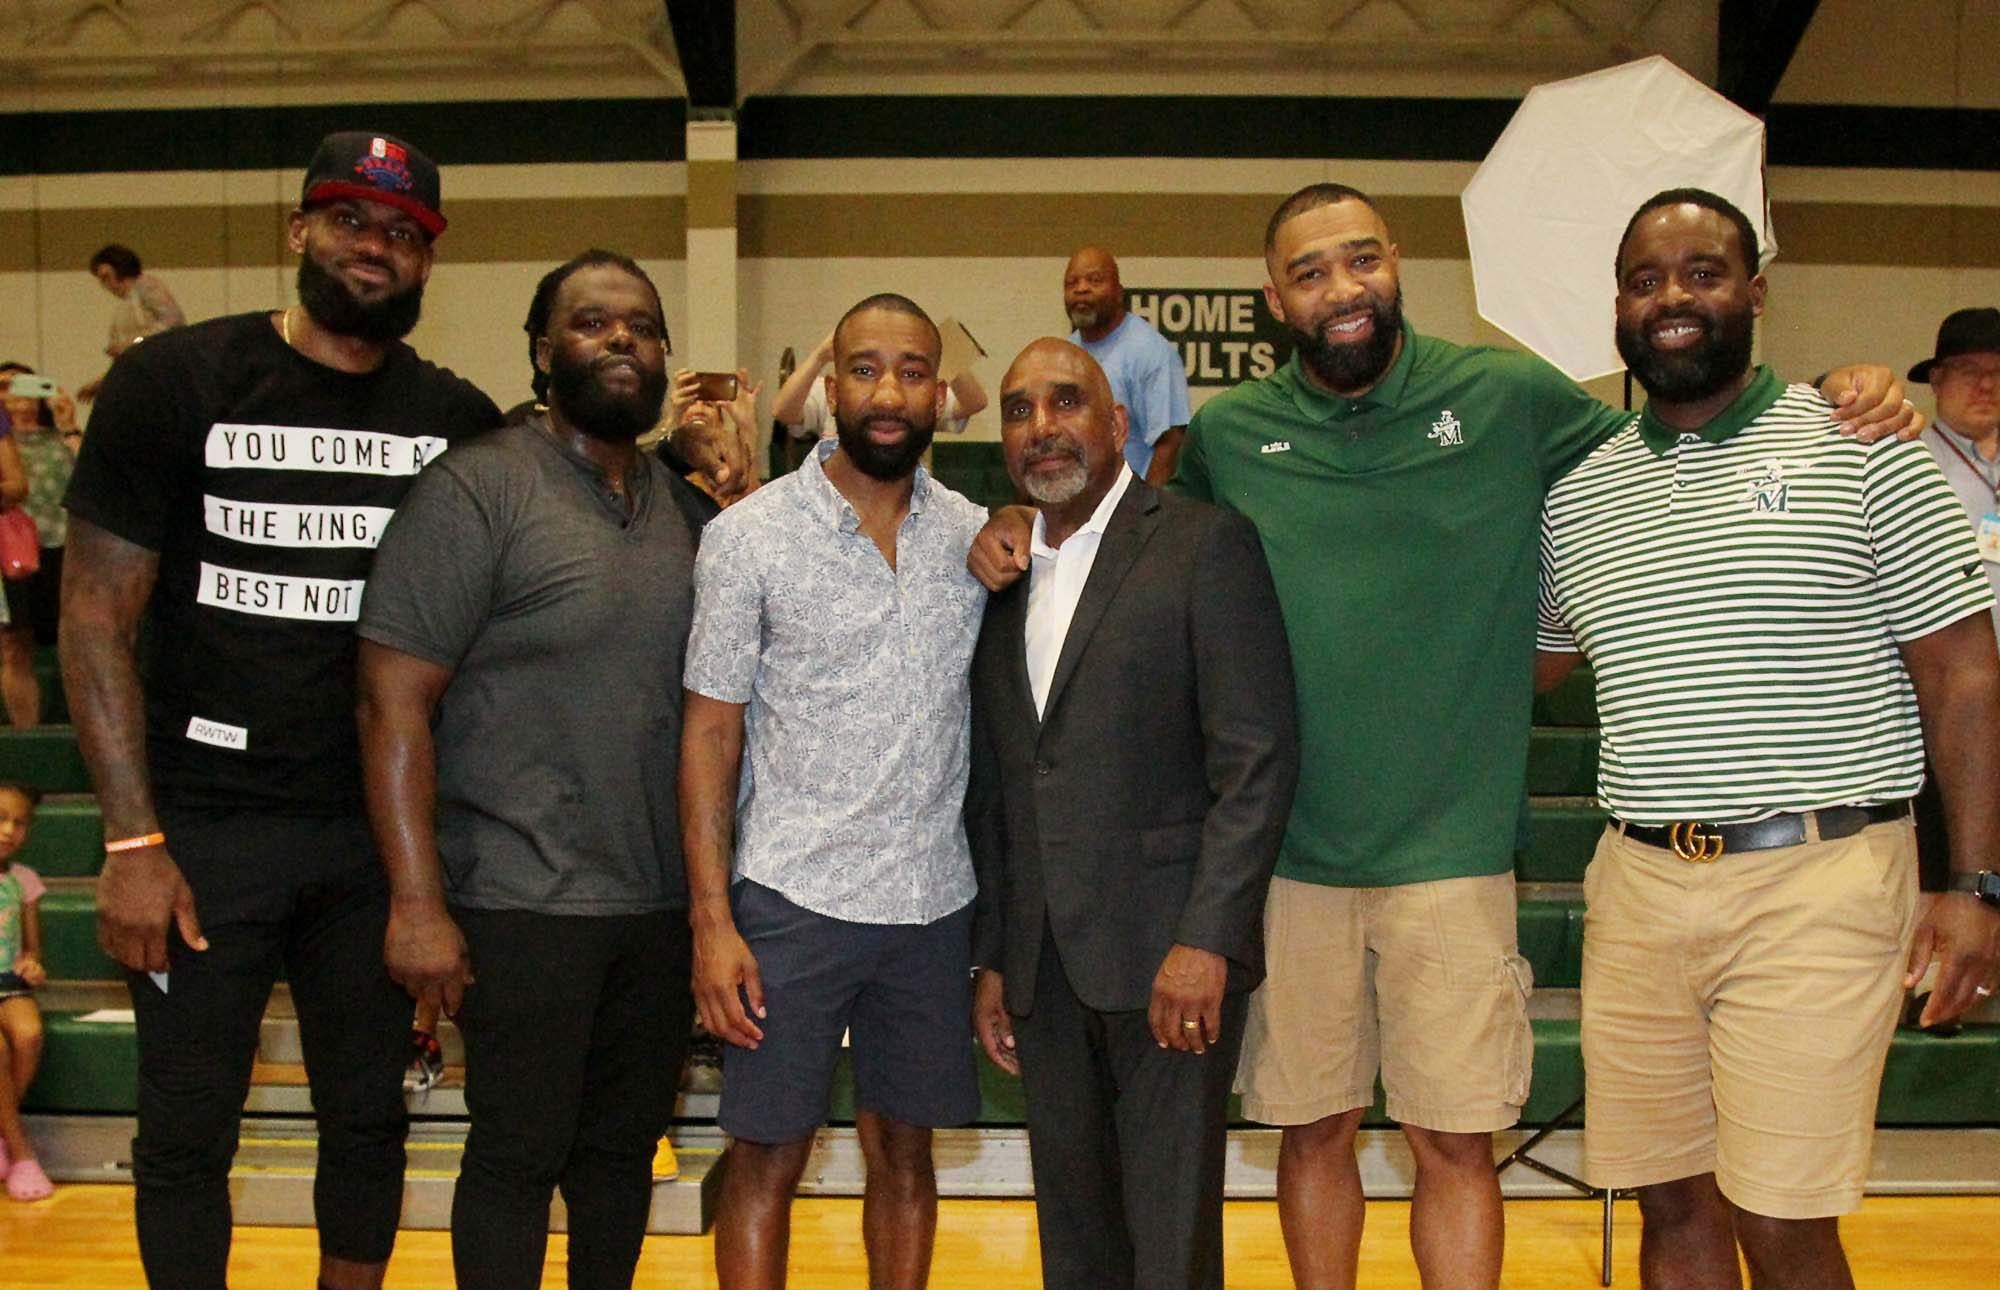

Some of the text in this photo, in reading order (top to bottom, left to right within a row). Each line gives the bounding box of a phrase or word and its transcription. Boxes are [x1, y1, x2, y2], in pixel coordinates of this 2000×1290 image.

[1131, 295, 1255, 332] HOME
[1171, 341, 1276, 379] ULTS
[224, 431, 286, 462] YOU
[312, 435, 391, 468] COME
[220, 505, 377, 543] THE KING,
[216, 572, 353, 614] BEST NOT
